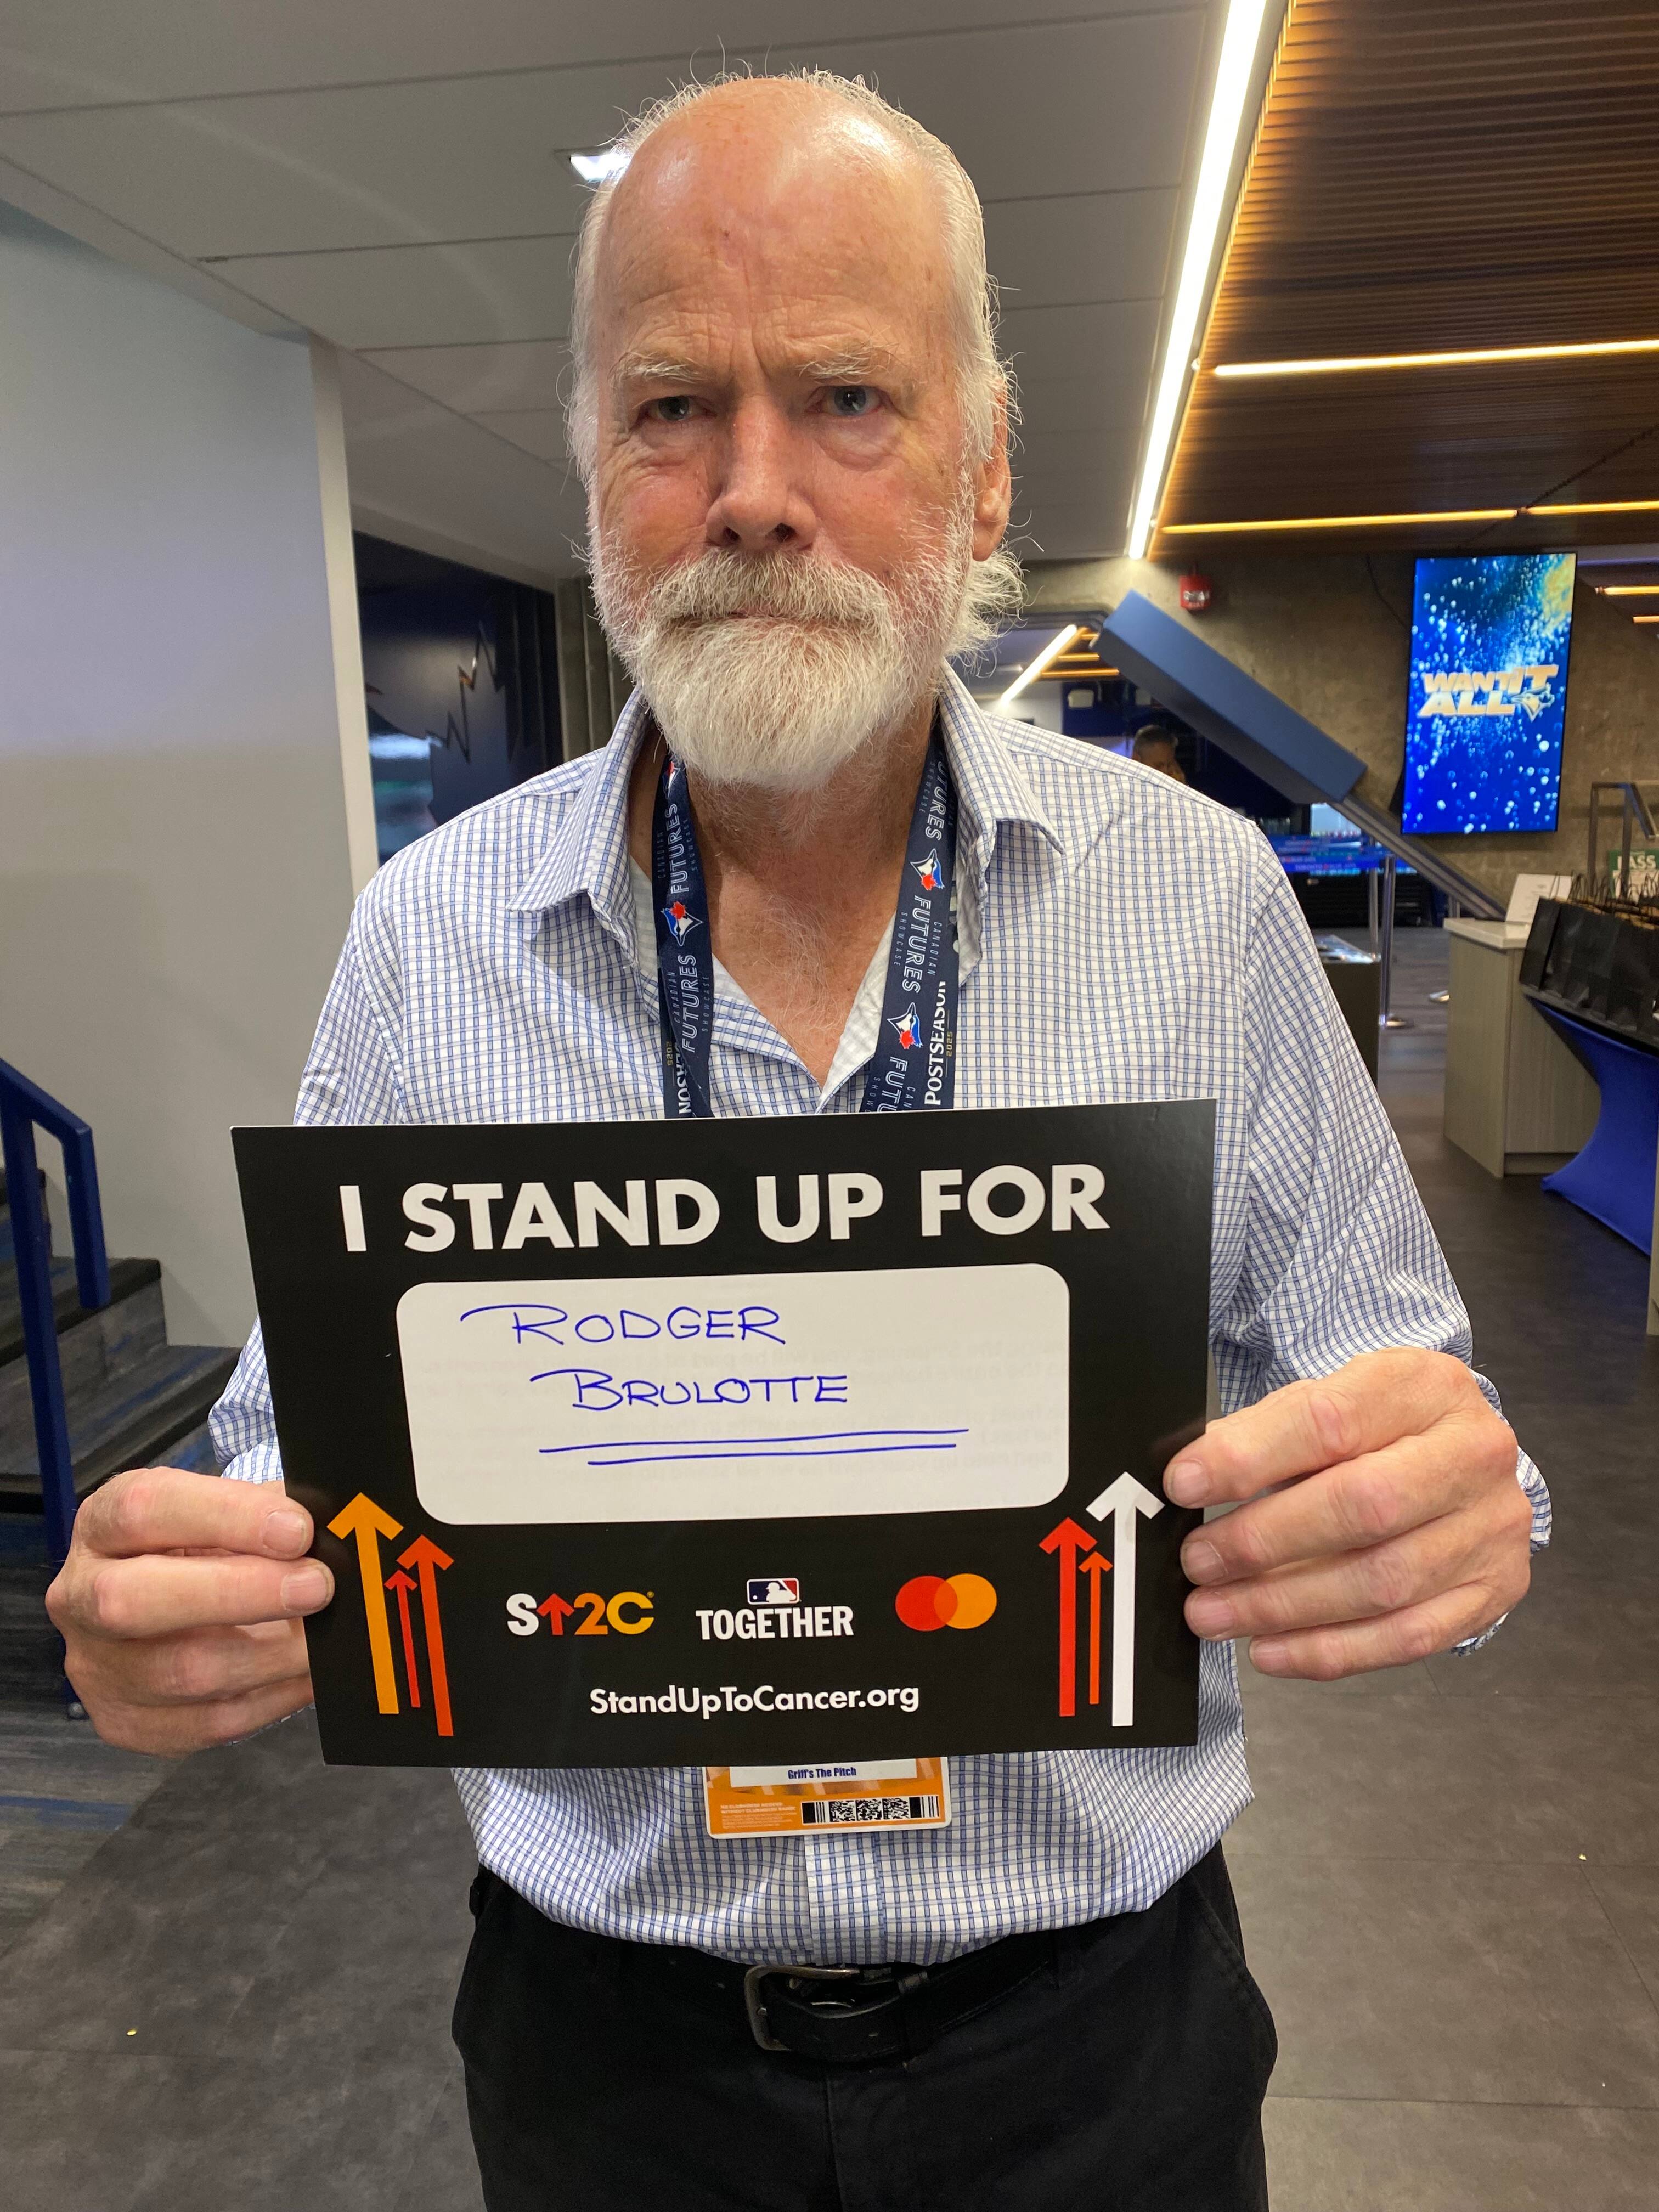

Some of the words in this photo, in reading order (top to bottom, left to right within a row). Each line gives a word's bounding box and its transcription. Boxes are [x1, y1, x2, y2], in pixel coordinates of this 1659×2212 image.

[1418, 690, 1516, 717] ALL
[1424, 671, 1513, 694] WANT
[1508, 664, 1559, 695] IT
[925, 760, 949, 841] UTURES
[664, 803, 690, 895] FUTURES
[1617, 855, 1657, 870] ASS
[894, 911, 908, 966] SHOWCASE
[902, 895, 932, 994] FUTURES
[927, 921, 943, 976] CANADIAN
[668, 971, 681, 1024] CANADIAN
[678, 954, 701, 1053] FUTURES
[702, 976, 710, 1032] SHOWCASE
[340, 1185, 367, 1252] I
[402, 1178, 720, 1252] STAND
[756, 1172, 883, 1243] UP
[920, 1164, 1110, 1237] FOR
[460, 1304, 785, 1344] RODGER
[530, 1368, 848, 1412] BRULOTTE
[696, 1605, 854, 1640] TOGETHER
[590, 1685, 919, 1720] StandUpToCancer.org
[788, 1769, 814, 1779] Griff's
[816, 1768, 832, 1778] The
[834, 1767, 856, 1777] Pitch
